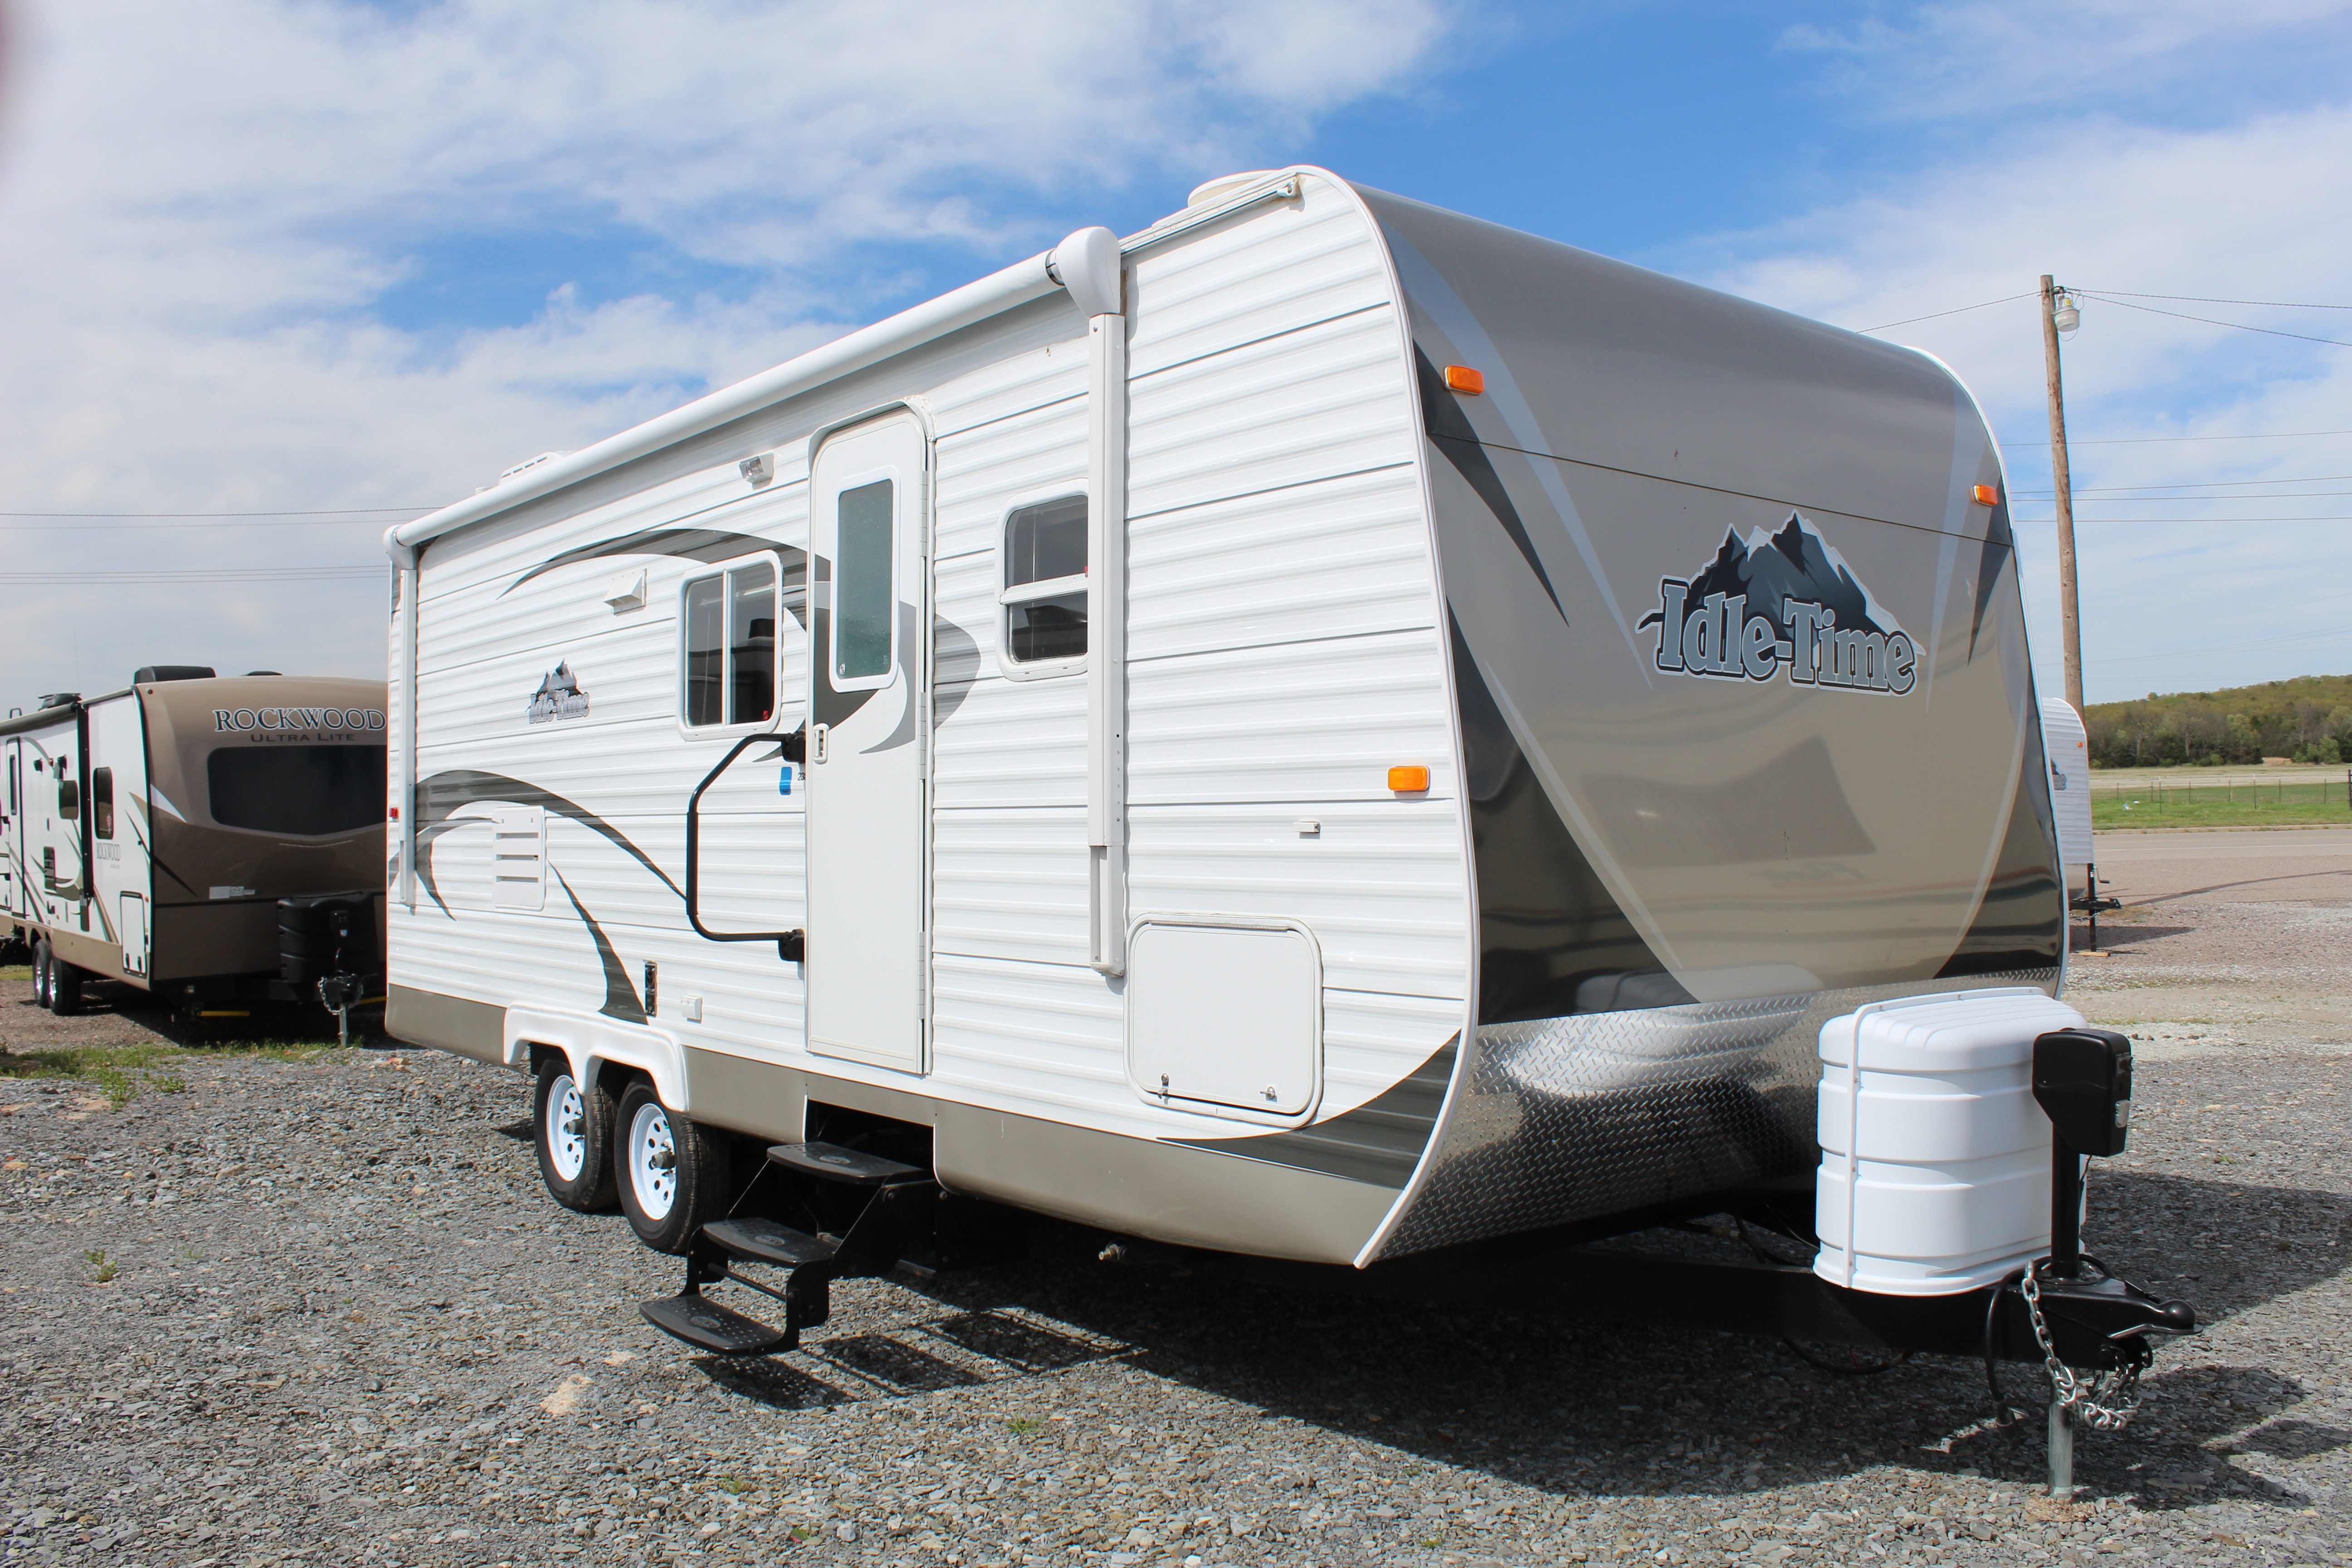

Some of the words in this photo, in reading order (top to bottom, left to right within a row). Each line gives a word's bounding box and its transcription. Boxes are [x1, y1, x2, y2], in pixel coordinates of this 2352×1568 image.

[1659, 583, 1914, 693] Idle-Time
[213, 707, 386, 731] ROCKWOOD
[529, 688, 589, 724] Idle-Time
[251, 734, 310, 742] ULTRA
[318, 732, 355, 741] LITE
